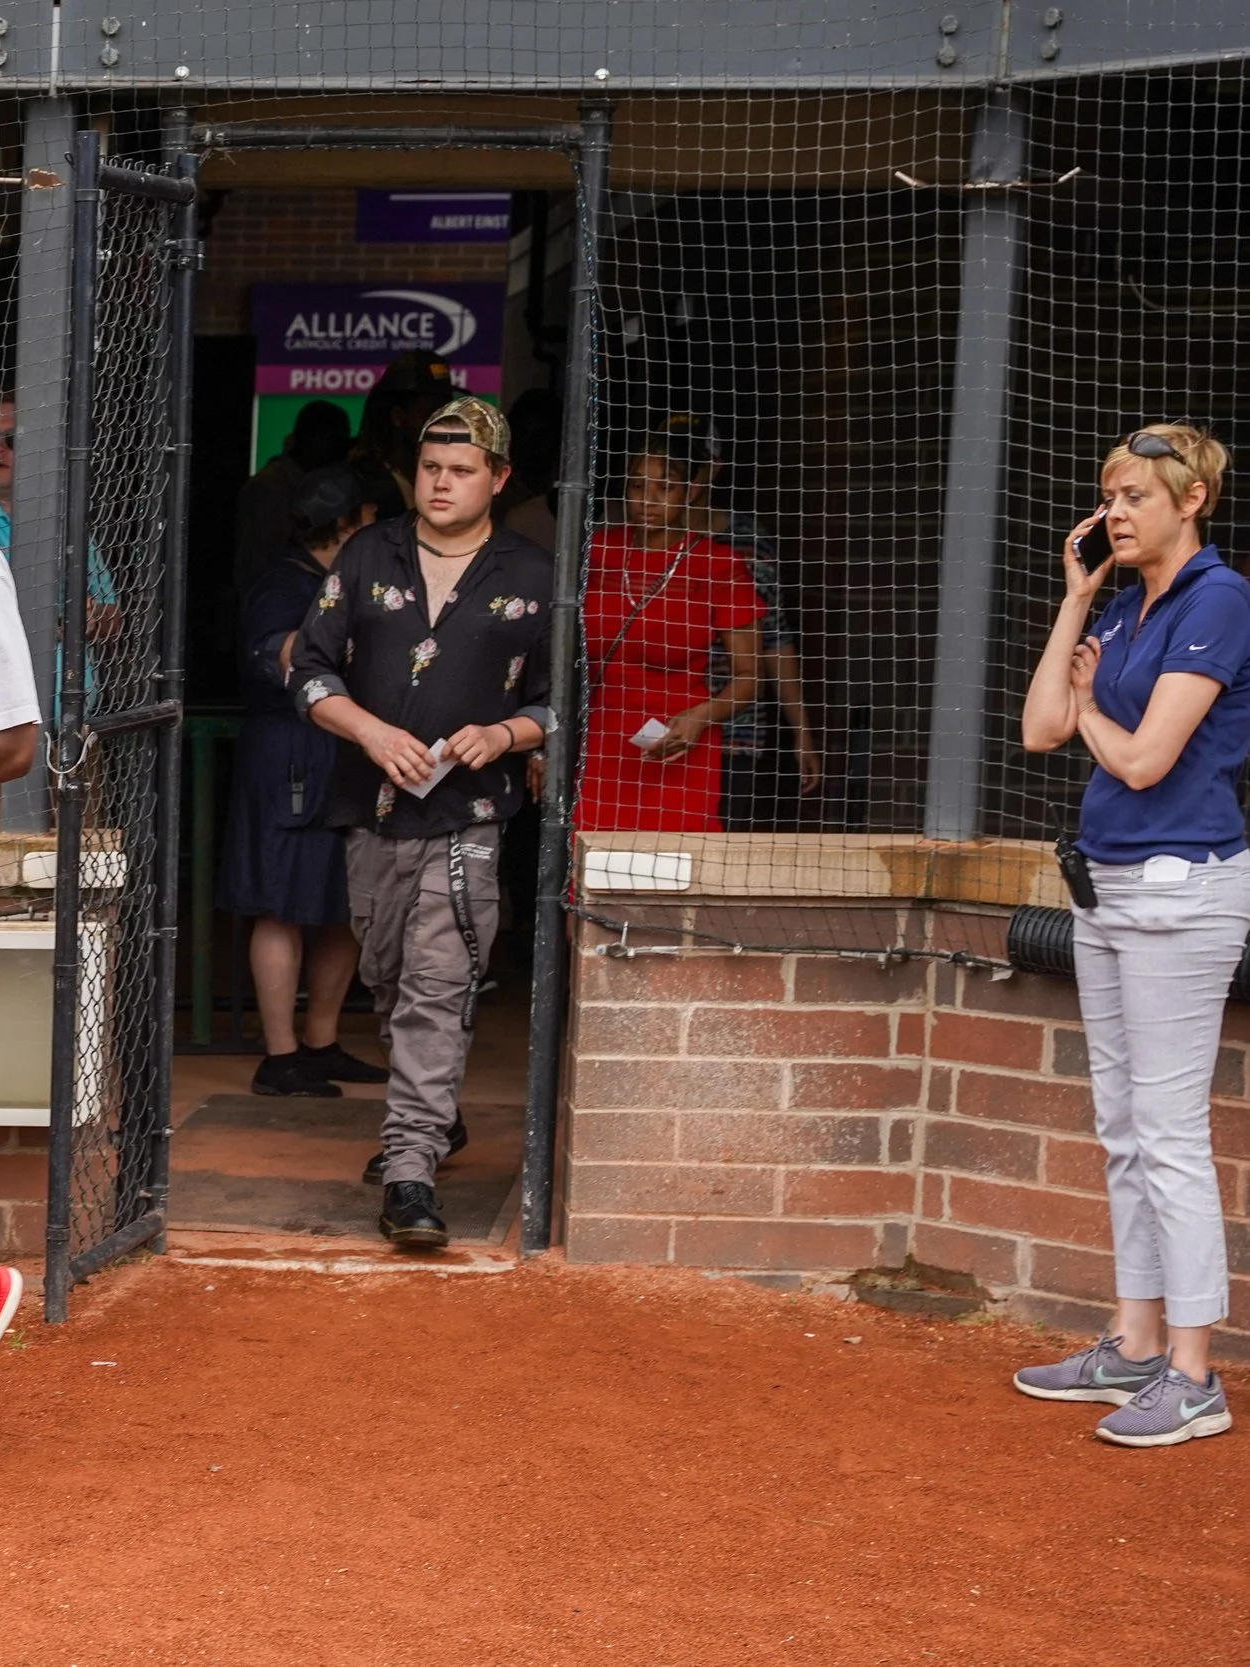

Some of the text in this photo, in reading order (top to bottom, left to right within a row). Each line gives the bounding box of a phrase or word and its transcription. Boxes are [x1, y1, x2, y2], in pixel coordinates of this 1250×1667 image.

[429, 213, 510, 229] ALBERT EINST
[285, 312, 435, 338] ALLIANCE
[284, 338, 435, 351] CATHOLIC CREDIT UNION
[290, 369, 374, 389] PHOTO
